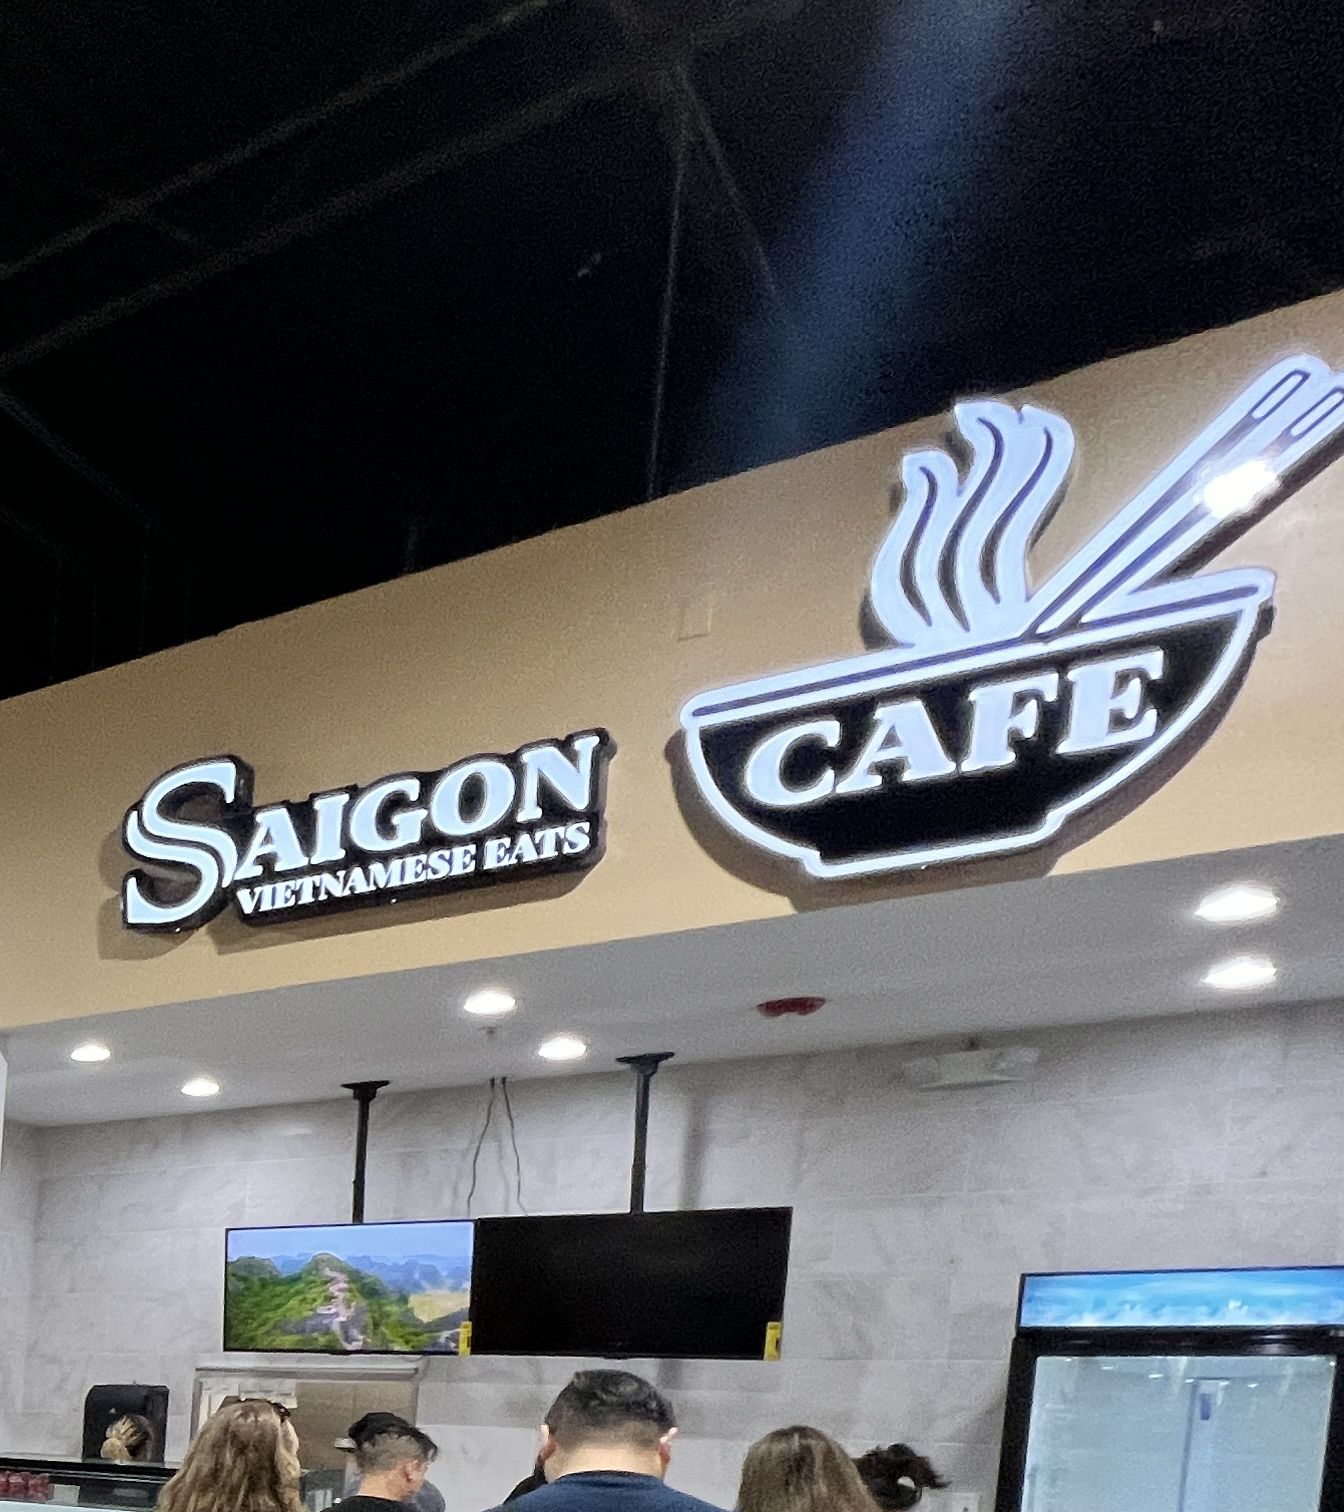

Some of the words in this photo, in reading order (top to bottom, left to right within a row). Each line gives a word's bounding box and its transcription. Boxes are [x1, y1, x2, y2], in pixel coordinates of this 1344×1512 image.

[744, 649, 1164, 807] CAFE
[123, 734, 600, 925] SAIGON
[235, 845, 477, 915] VIETNAMESE
[482, 821, 591, 870] EATS
